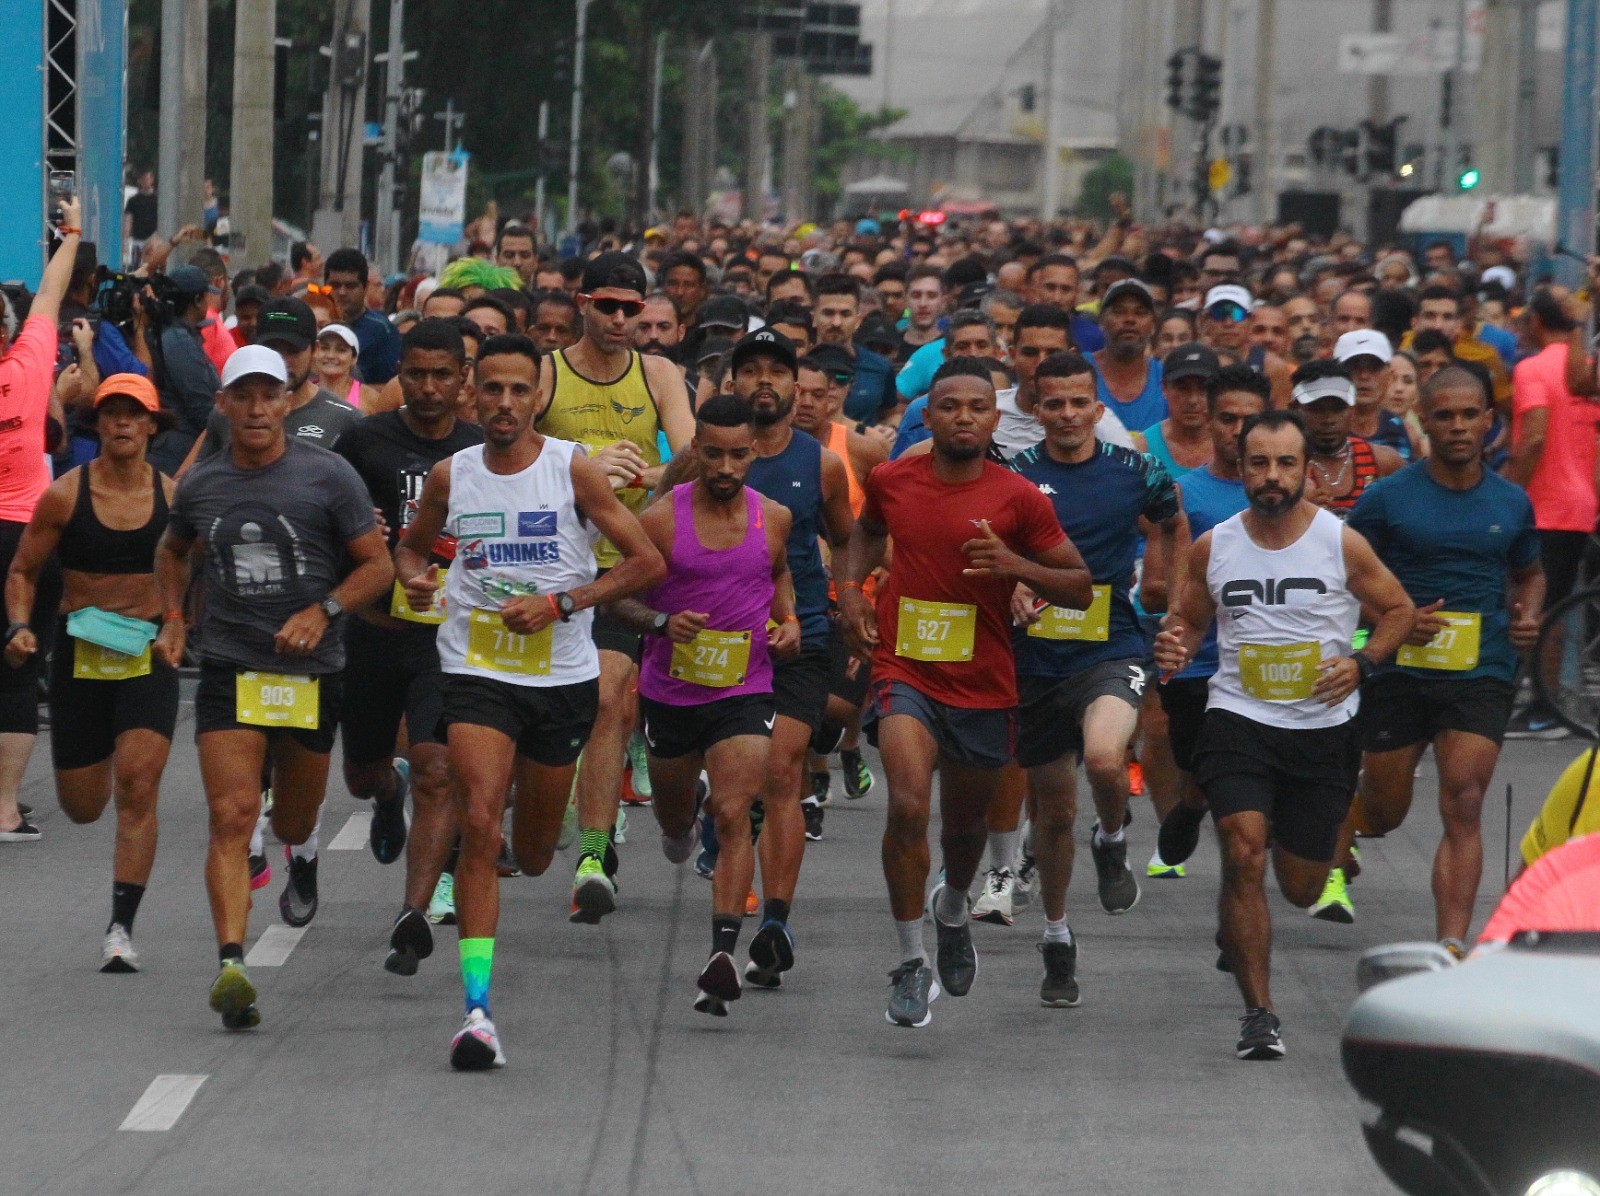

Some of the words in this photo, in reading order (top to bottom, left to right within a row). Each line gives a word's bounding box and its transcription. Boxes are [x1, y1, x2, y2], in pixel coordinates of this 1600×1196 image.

[488, 541, 559, 562] UNIMES
[493, 629, 526, 653] 711
[917, 619, 951, 641] 527
[694, 645, 729, 668] 274
[1258, 662, 1303, 682] 1002
[260, 685, 294, 707] 903
